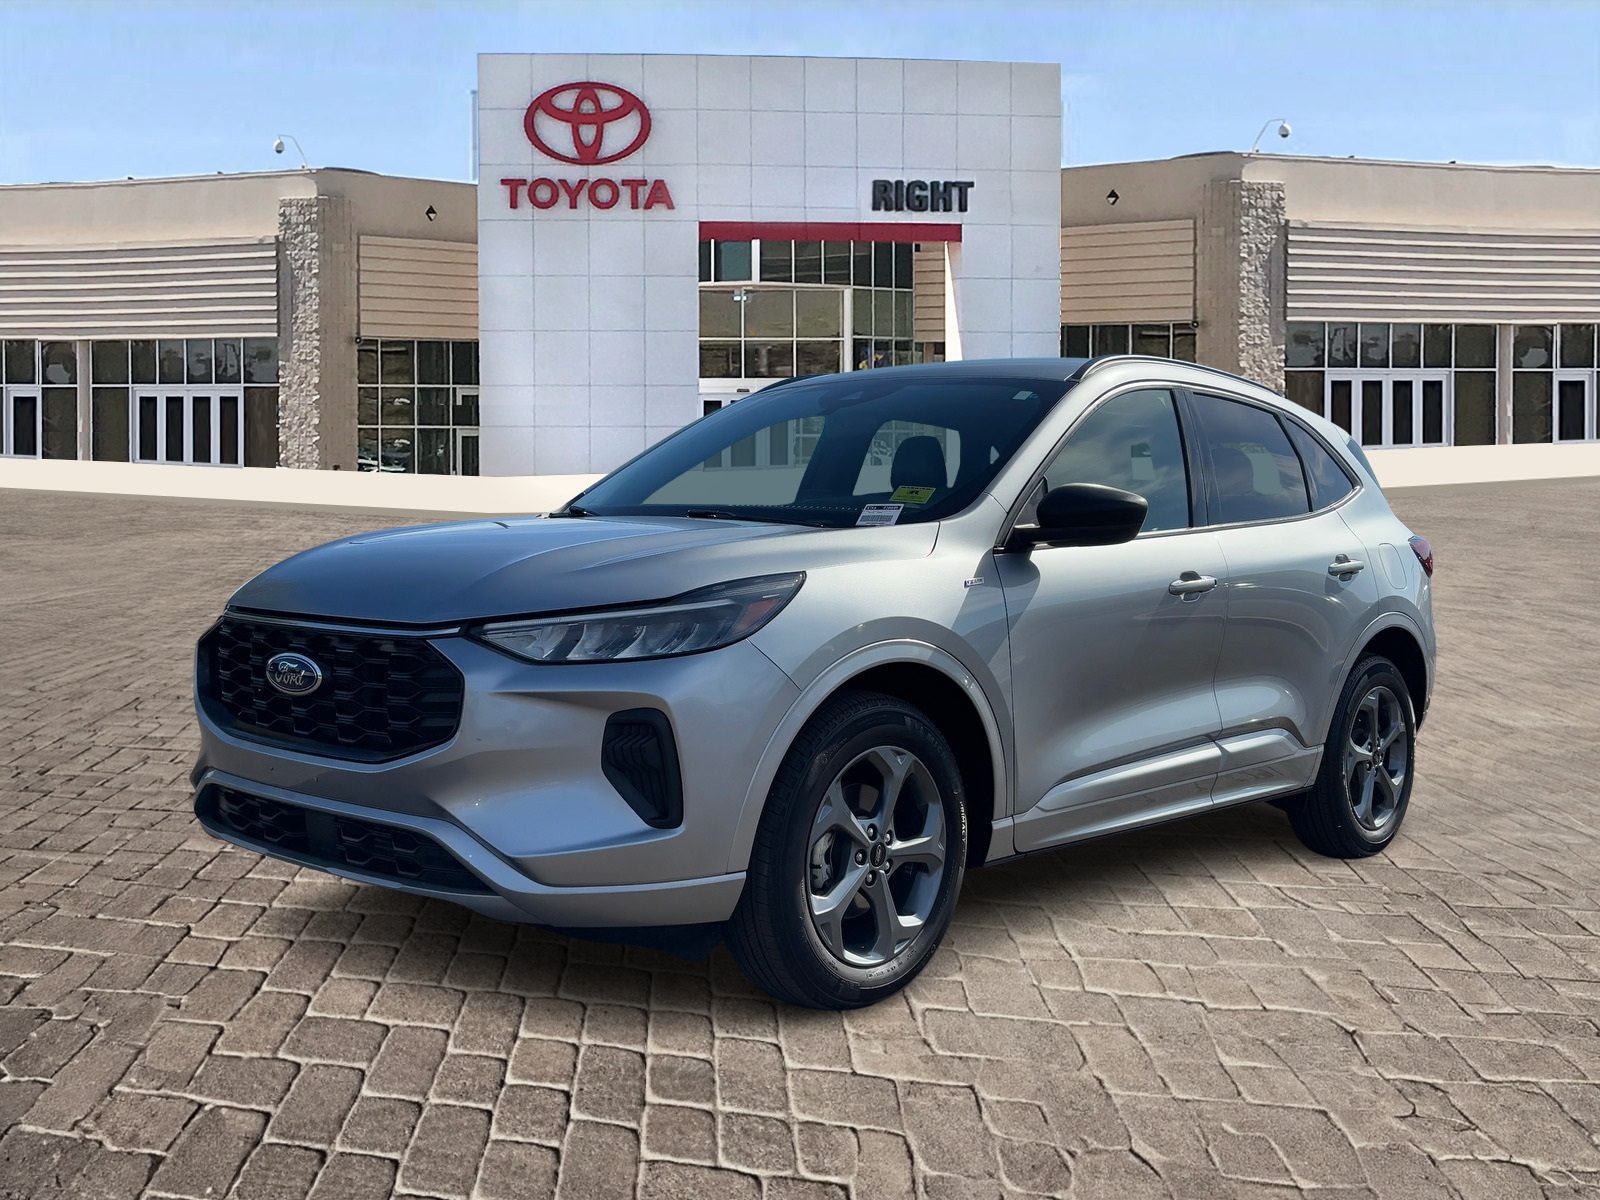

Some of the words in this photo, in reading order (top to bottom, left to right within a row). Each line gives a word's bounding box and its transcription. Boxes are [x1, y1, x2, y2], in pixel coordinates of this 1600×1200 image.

[500, 178, 675, 210] TOYOTA
[872, 179, 975, 213] RIGHT
[274, 660, 305, 686] Ford
